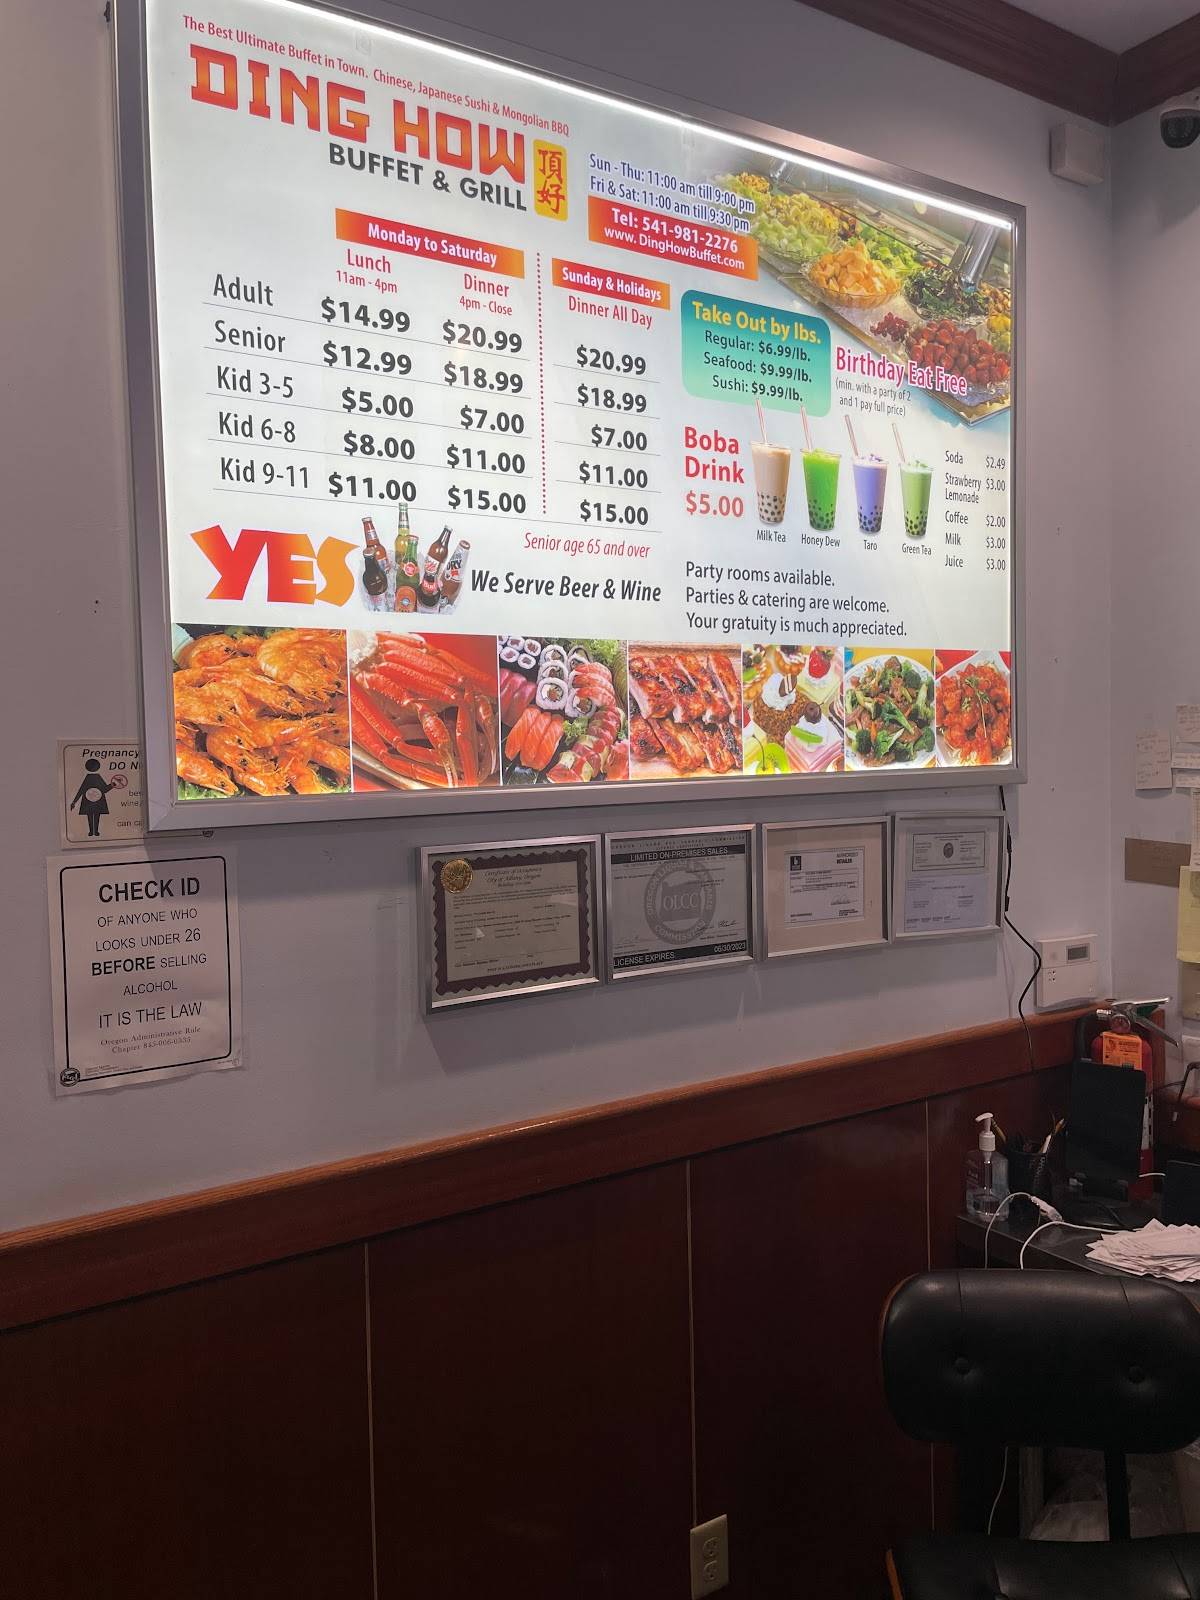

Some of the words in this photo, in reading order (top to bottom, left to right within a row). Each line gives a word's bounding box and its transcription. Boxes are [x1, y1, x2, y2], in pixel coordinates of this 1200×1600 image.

[183, 15, 205, 33] The
[208, 22, 233, 41] Best
[236, 29, 285, 55] Ultimate
[289, 44, 322, 66] Buffet
[325, 54, 335, 68] in
[418, 81, 462, 105] Japanese
[465, 95, 490, 113] Sushi
[502, 105, 549, 131] Mongolian
[551, 120, 570, 138] BBQ
[190, 43, 370, 143] DING
[393, 99, 525, 184] HOW
[329, 142, 423, 185] BUFFET
[432, 170, 450, 193] &
[459, 177, 527, 211] GRILL
[537, 148, 566, 214] 頂好
[590, 153, 611, 173] Sun
[647, 170, 677, 191] 11:00
[679, 182, 695, 197] am
[698, 185, 712, 201] till
[715, 188, 736, 207] 9:00
[739, 197, 755, 213] pm
[590, 176, 605, 193] Fri
[641, 191, 672, 210] 11:00
[674, 201, 690, 217] am
[693, 205, 708, 221] till
[710, 208, 732, 228] 9:30
[734, 216, 750, 233] pm
[611, 208, 638, 228] Tel:
[642, 216, 738, 254] 541-981-2276
[368, 222, 421, 249] Monday
[424, 237, 437, 252] to
[441, 240, 497, 267] Saturday
[347, 249, 391, 273] Lunch
[336, 270, 366, 287] 11am
[374, 280, 398, 294] 4pm
[464, 273, 509, 297] Dinner
[562, 267, 603, 291] Sunday
[616, 278, 662, 303] Holidays
[459, 296, 480, 310] 4pm
[489, 300, 513, 316] Close
[568, 295, 609, 318] Dinner
[612, 304, 628, 322] All
[632, 308, 652, 330] Day
[213, 273, 274, 307] Adult
[321, 296, 410, 333] $14.99
[442, 319, 522, 353] $20.99
[576, 344, 647, 376] $20.99
[692, 301, 732, 325] Take
[736, 312, 766, 333] Out
[771, 317, 790, 341] by
[705, 330, 754, 351] Regular:
[214, 320, 286, 353] Senior
[323, 340, 412, 375] $12.99
[444, 360, 523, 394] $18.99
[577, 383, 647, 413] $18.99
[704, 351, 756, 373] Seafood:
[836, 347, 904, 388] Birthday
[909, 361, 933, 389] Eat
[936, 367, 967, 394] Free
[712, 375, 748, 392] Sushi:
[856, 382, 871, 394] with
[879, 387, 896, 401] party
[217, 365, 252, 393] Kid
[259, 372, 294, 399] 3-5
[341, 386, 414, 418] $5.00
[460, 404, 525, 434] $7.00
[591, 424, 648, 451] $7.00
[218, 411, 253, 438] Kid
[261, 418, 296, 443] 6-8
[343, 429, 416, 460] $8.00
[446, 443, 526, 474] $11.00
[579, 461, 648, 489] $11.00
[684, 426, 740, 455] Boba
[685, 455, 745, 484] Drink
[945, 450, 964, 464] Soda
[985, 456, 1006, 470] $2.49
[220, 456, 255, 483] Kid
[262, 462, 308, 489] 9-11
[328, 471, 417, 502] $11.00
[447, 485, 527, 514] $15.00
[580, 499, 649, 526] $15.00
[945, 473, 981, 491] Strawberry
[985, 478, 1006, 491] $3.00
[685, 490, 744, 518] $5.00
[945, 488, 979, 504] Lemonade
[945, 510, 969, 525] Coffee
[985, 515, 1006, 528] $2.00
[524, 532, 561, 551] Senior
[563, 541, 584, 557] age
[587, 538, 601, 555] 65
[603, 540, 624, 557] and
[626, 544, 651, 559] over
[756, 529, 772, 542] Milk
[773, 531, 786, 543] Tea
[801, 533, 824, 548] Honey
[824, 535, 841, 548] Dew
[863, 539, 878, 551] Taro
[945, 532, 961, 546] Milk
[985, 537, 1006, 550] $3.00
[921, 544, 932, 556] Tea
[944, 554, 964, 568] Juice
[986, 558, 1006, 571] $3.00
[190, 524, 360, 607] YES
[686, 561, 724, 582] Party
[727, 568, 770, 583] rooms
[773, 569, 835, 587] available.
[470, 569, 499, 593] We
[504, 572, 555, 596] Serve
[559, 575, 600, 598] Beer
[603, 578, 616, 600] &
[621, 579, 662, 602] Wine
[686, 587, 734, 606] Parties
[738, 590, 749, 606] &
[752, 591, 806, 612] catering
[809, 598, 830, 610] are
[833, 596, 890, 613] welcome.
[686, 612, 718, 630] Your
[722, 615, 777, 635] gratuity
[780, 617, 790, 632] is
[794, 617, 829, 634] much
[832, 619, 907, 638] appreciated.
[82, 748, 140, 760] Pregnancy
[109, 761, 126, 771] DO
[630, 852, 657, 863] LIMITED
[660, 847, 706, 860] ON-PREMISES
[708, 846, 728, 856] SALES
[99, 879, 174, 903] CHECK
[181, 877, 200, 896] ID
[97, 915, 113, 928] OF
[118, 911, 166, 926] ANYONE
[170, 908, 198, 920] WHO
[96, 937, 135, 952] LOOKS
[141, 933, 180, 947] UNDER
[185, 928, 201, 942] 26
[92, 956, 155, 976] BEFORE
[160, 953, 207, 969] SELLING
[614, 955, 643, 967] LICENSE
[645, 951, 675, 963] EXPIRES
[123, 980, 178, 996] ALCOHOL
[99, 1014, 113, 1029] IT
[118, 1012, 131, 1026] IS
[136, 1007, 165, 1023] THE
[171, 1002, 202, 1019] LAW
[100, 1037, 128, 1047] Oregon
